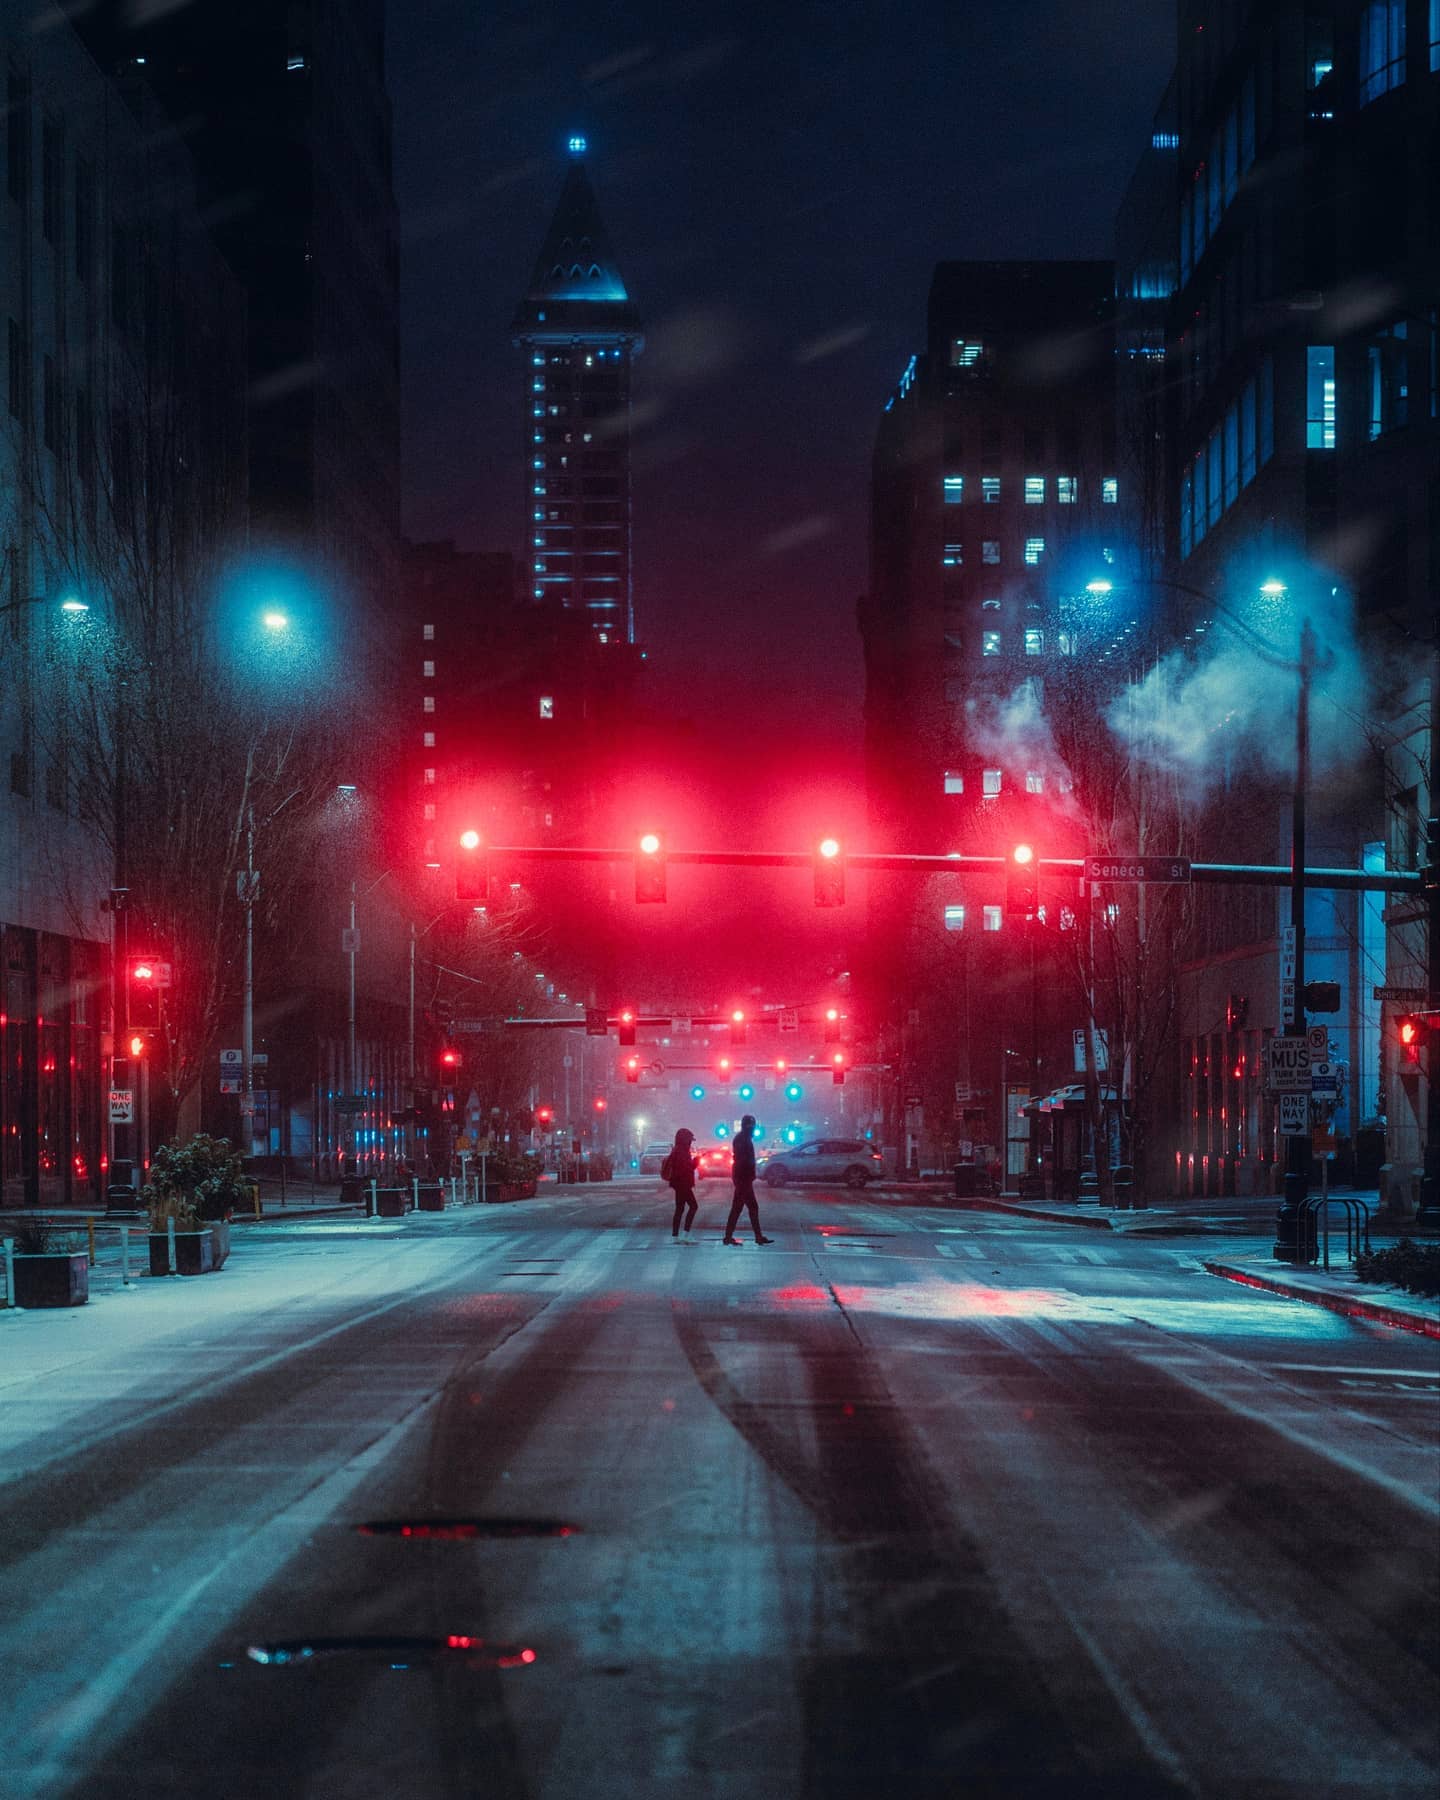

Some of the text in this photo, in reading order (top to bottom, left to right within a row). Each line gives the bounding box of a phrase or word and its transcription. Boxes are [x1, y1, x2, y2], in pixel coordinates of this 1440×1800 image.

[1091, 862, 1183, 877] Seneca St
[1271, 1050, 1310, 1069] MUS
[111, 1092, 130, 1101] ONE
[1282, 1096, 1305, 1107] ONE
[111, 1101, 130, 1110] WAY
[1282, 1108, 1305, 1119] WAY
